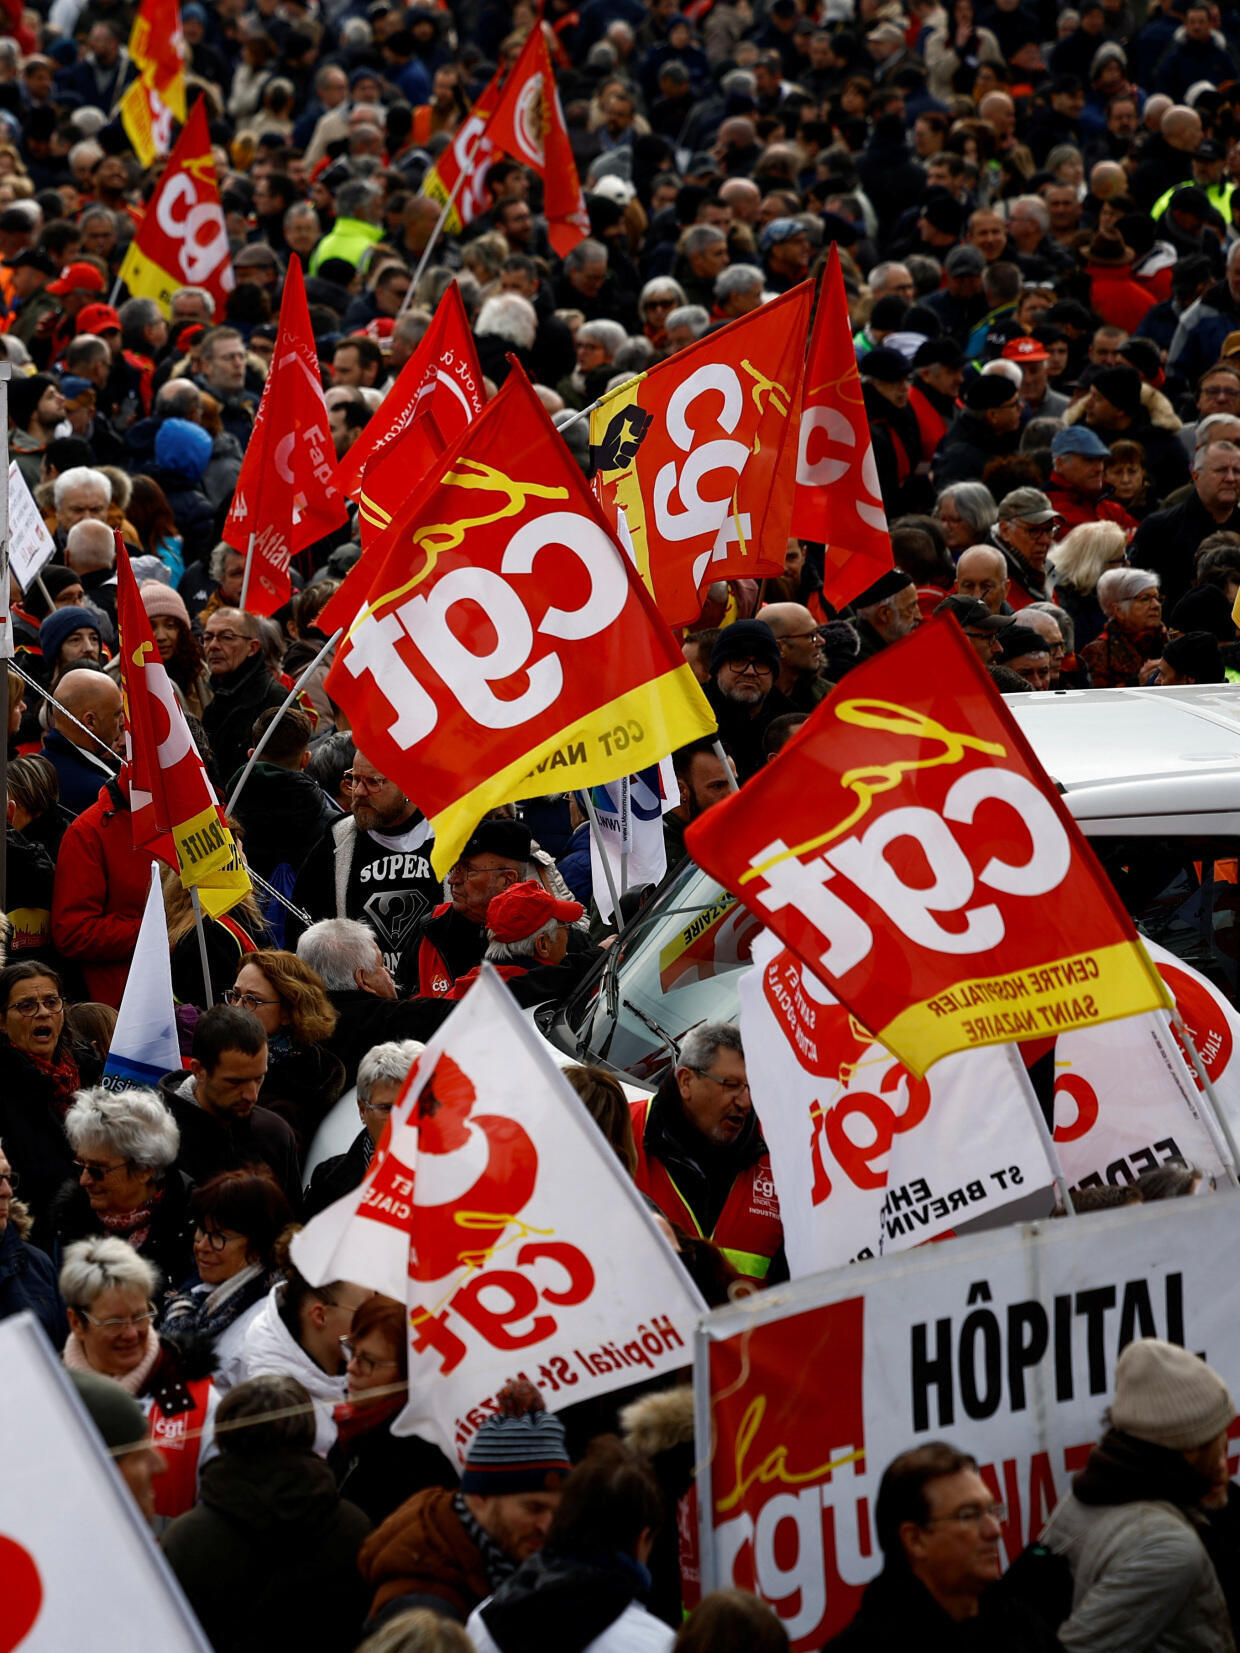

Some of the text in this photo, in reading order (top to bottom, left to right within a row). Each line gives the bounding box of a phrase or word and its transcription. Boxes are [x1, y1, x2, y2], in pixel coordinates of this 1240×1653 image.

[360, 853, 431, 883] SUPER
[910, 1272, 1207, 1434] HÔPITAL
[155, 1419, 184, 1439] cgt
